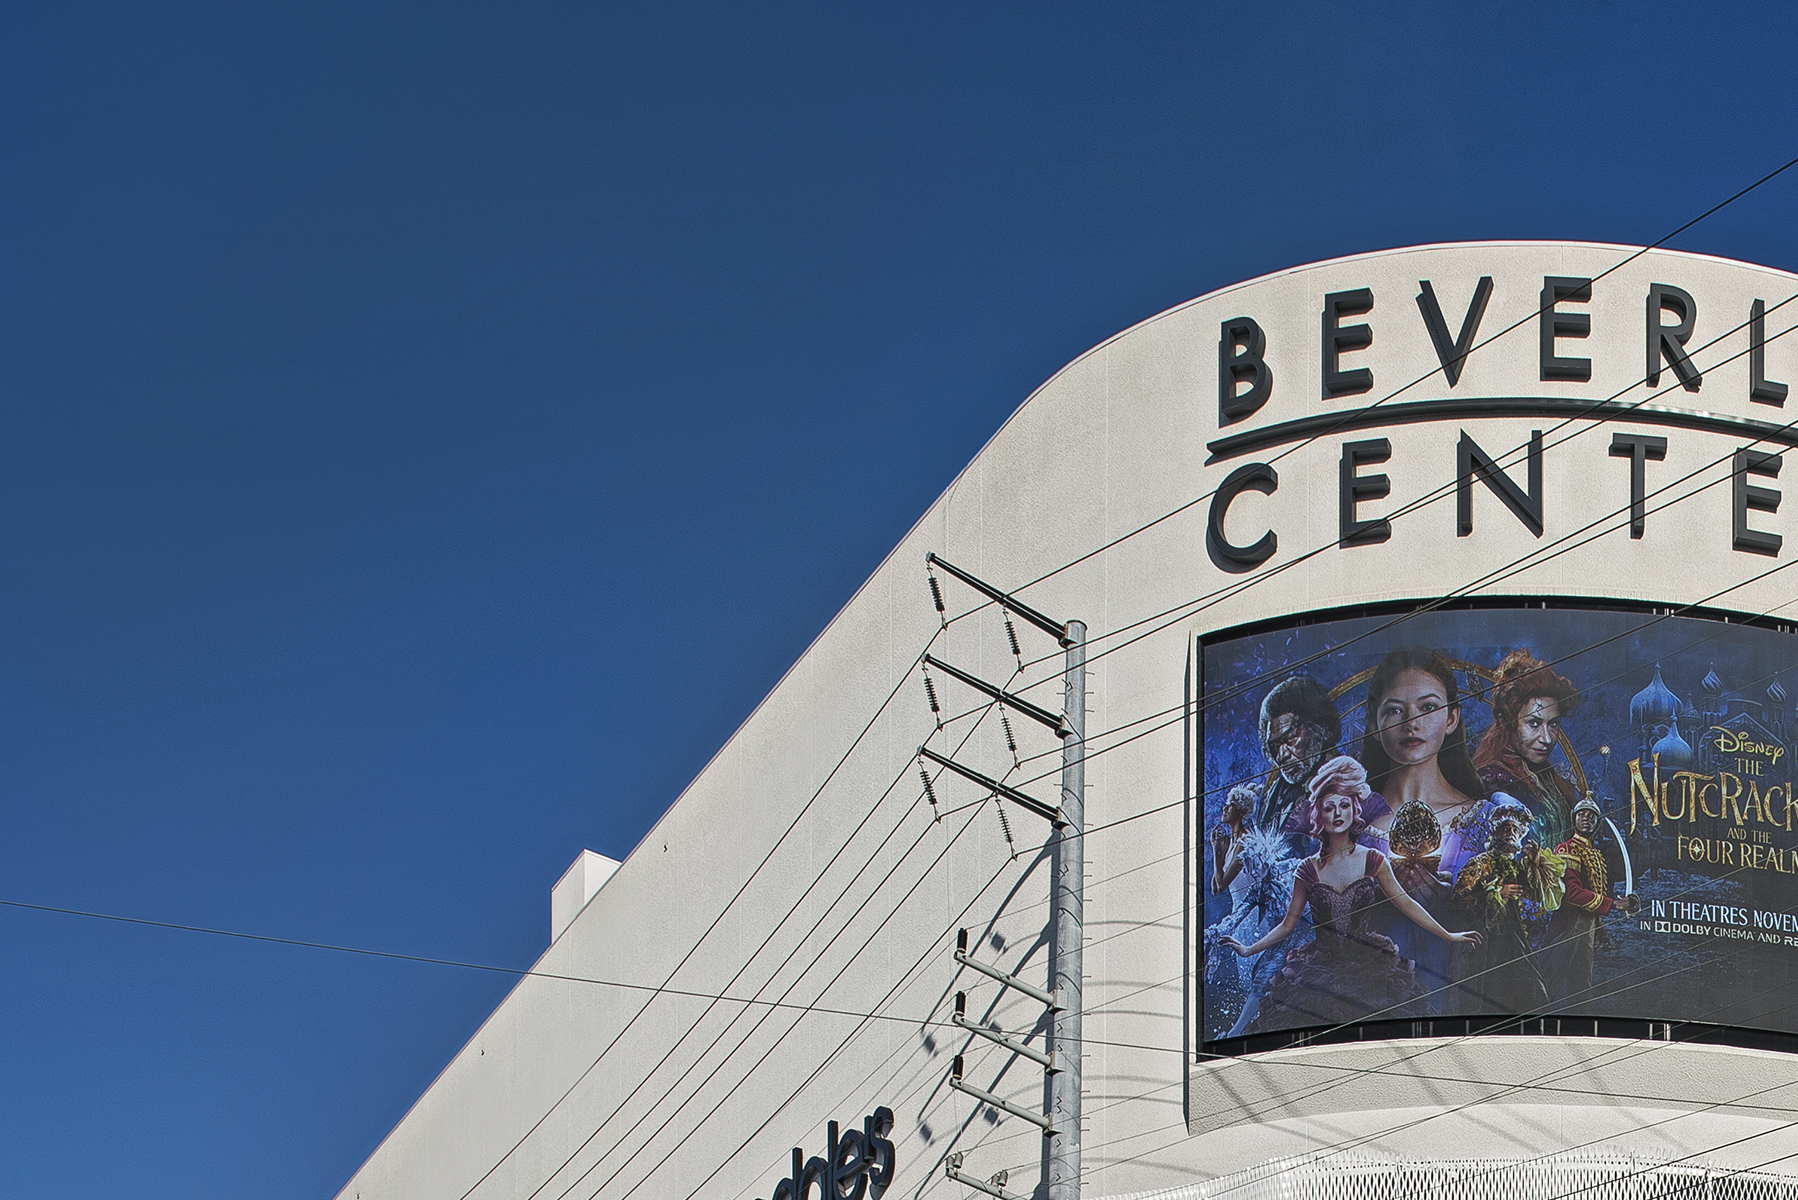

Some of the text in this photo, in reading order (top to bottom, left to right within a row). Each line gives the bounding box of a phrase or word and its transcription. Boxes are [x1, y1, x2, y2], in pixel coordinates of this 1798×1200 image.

[1735, 757, 1765, 777] THE
[1727, 827, 1773, 844] AND THE
[1678, 834, 1734, 866] FOUR
[1651, 900, 1666, 917] IN
[1669, 901, 1748, 926] THEATRES
[1640, 920, 1651, 930] IN
[1672, 923, 1711, 935] DOLBY
[1757, 932, 1781, 944] AND
